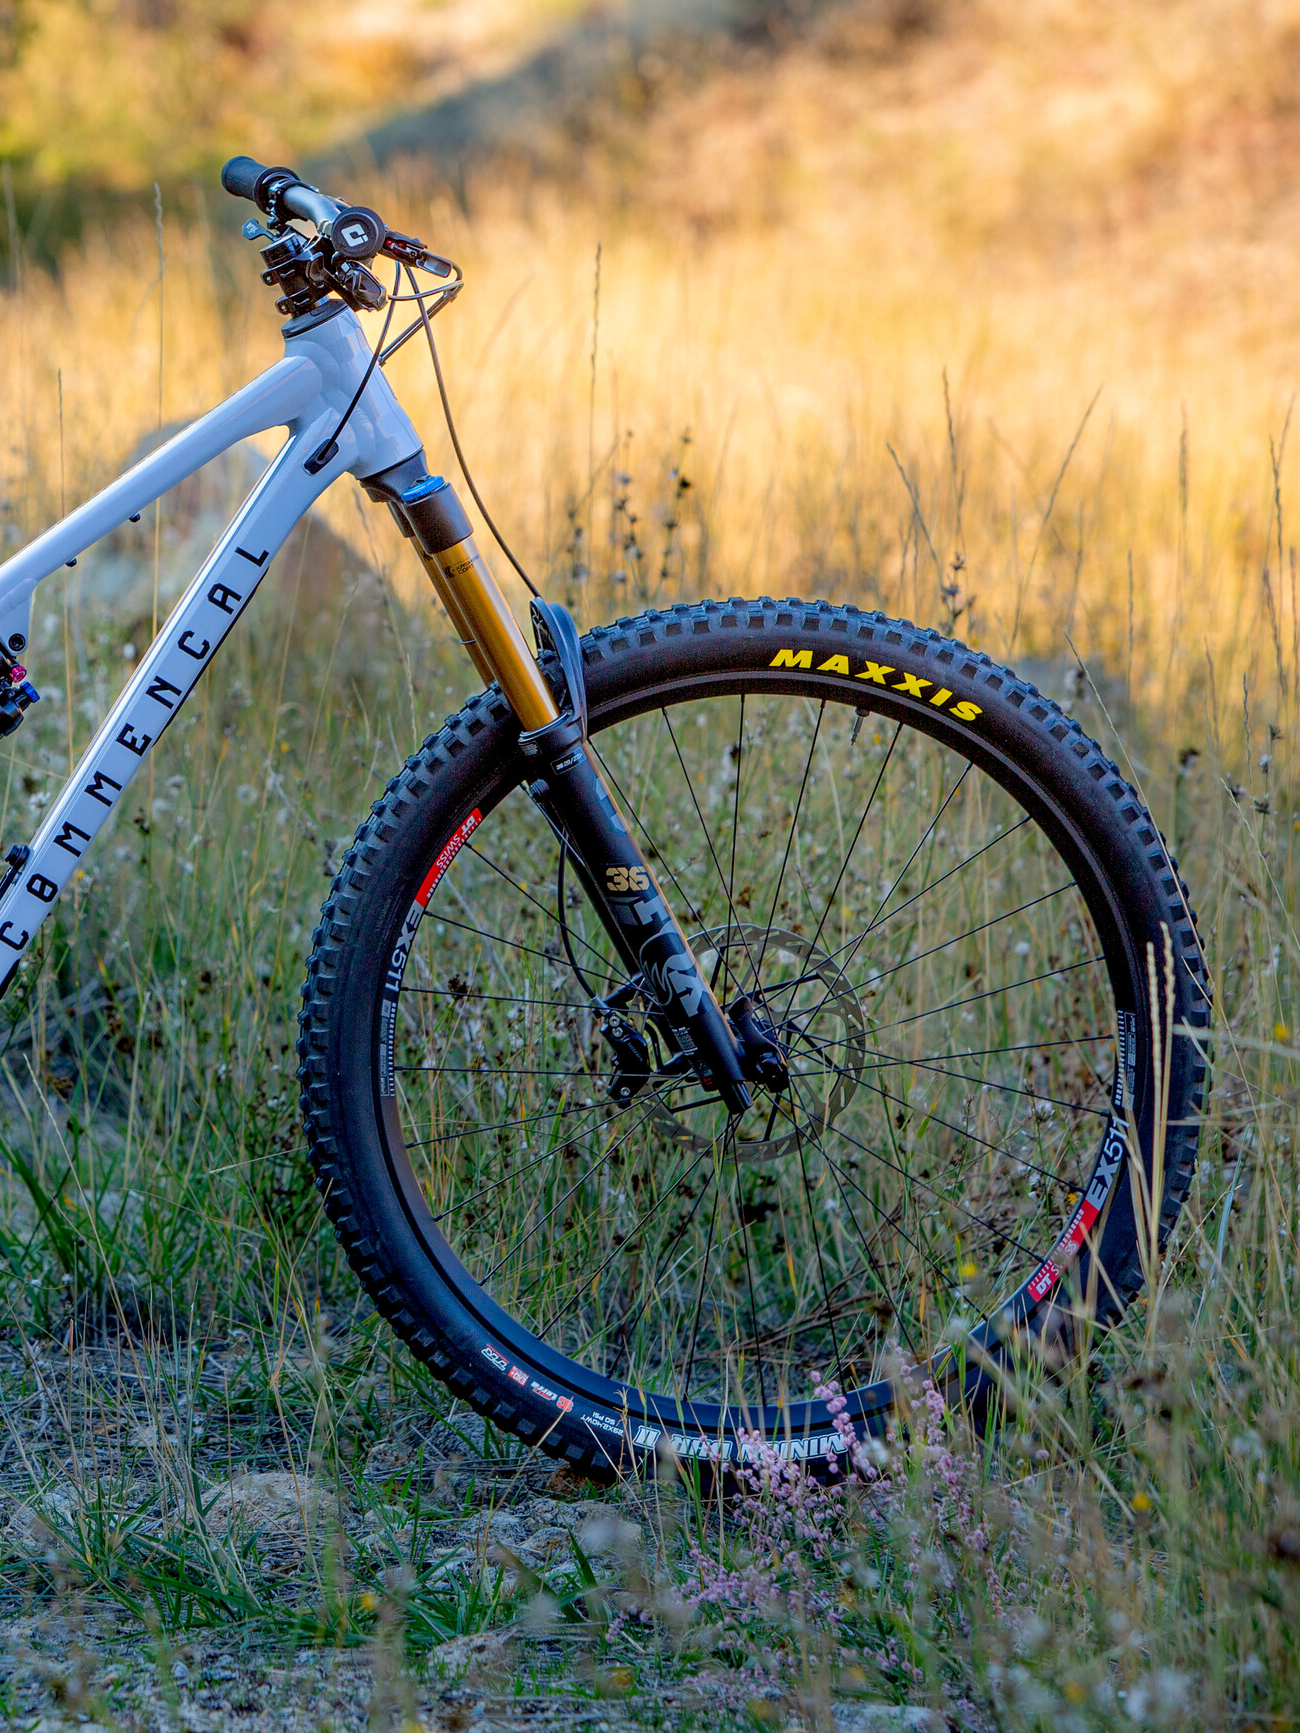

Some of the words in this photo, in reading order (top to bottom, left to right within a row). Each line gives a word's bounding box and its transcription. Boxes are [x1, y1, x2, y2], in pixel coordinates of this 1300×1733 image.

[769, 649, 983, 721] MAXXIS
[459, 814, 476, 834] DT
[436, 832, 461, 869] SWISS
[606, 866, 649, 891] 36
[384, 901, 424, 993] EX511
[1086, 1115, 1130, 1210] EX511
[1037, 1275, 1052, 1296] DT
[480, 1347, 507, 1372] TR
[509, 1370, 528, 1385] EXO+
[580, 1413, 624, 1437] 29X2.40WT
[592, 1411, 605, 1421] PSI
[604, 1417, 617, 1426] 50
